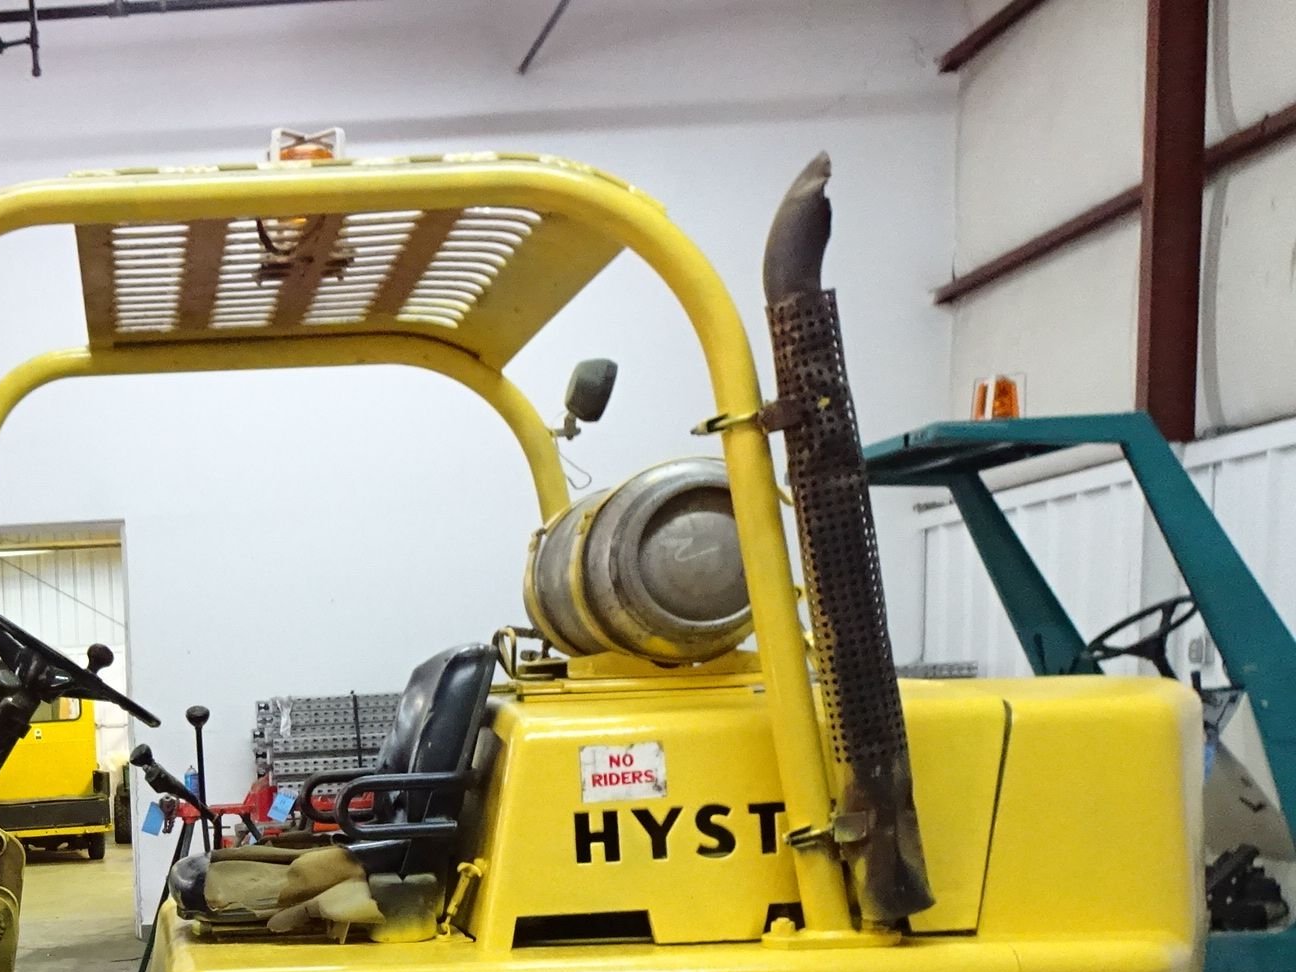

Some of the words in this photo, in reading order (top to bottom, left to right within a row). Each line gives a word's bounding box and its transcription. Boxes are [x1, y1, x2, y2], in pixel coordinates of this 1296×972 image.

[609, 754, 634, 768] NO
[592, 770, 655, 787] RIDERS
[573, 802, 786, 864] HYST
